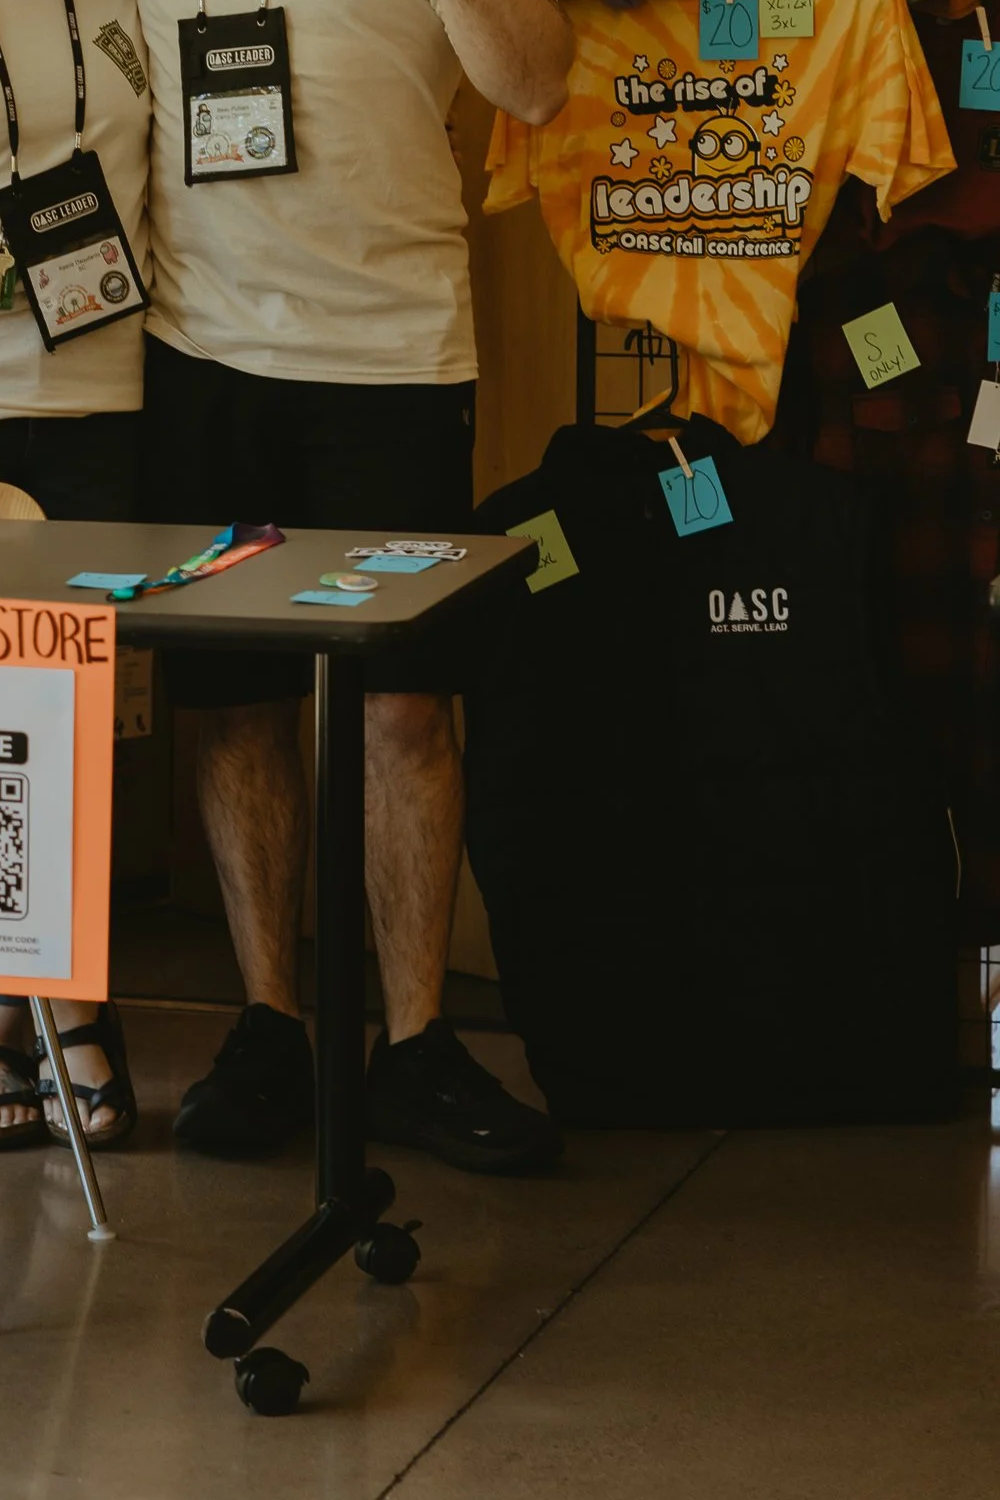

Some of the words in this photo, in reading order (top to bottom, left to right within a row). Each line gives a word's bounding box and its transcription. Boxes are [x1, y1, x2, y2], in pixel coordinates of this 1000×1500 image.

[701, 0, 753, 48] $20
[234, 47, 271, 63] LEADER
[616, 77, 666, 105] the
[674, 74, 729, 101] rise
[735, 69, 767, 97] of
[59, 194, 96, 218] LEADER
[595, 171, 812, 222] leadership
[620, 232, 673, 252] OASC
[676, 236, 703, 255] fall
[707, 239, 791, 256] conference
[863, 331, 883, 363] S
[869, 344, 906, 382] ONLY!
[665, 468, 719, 526] $20
[731, 623, 763, 633] SERVE.
[764, 622, 788, 632] LEAD
